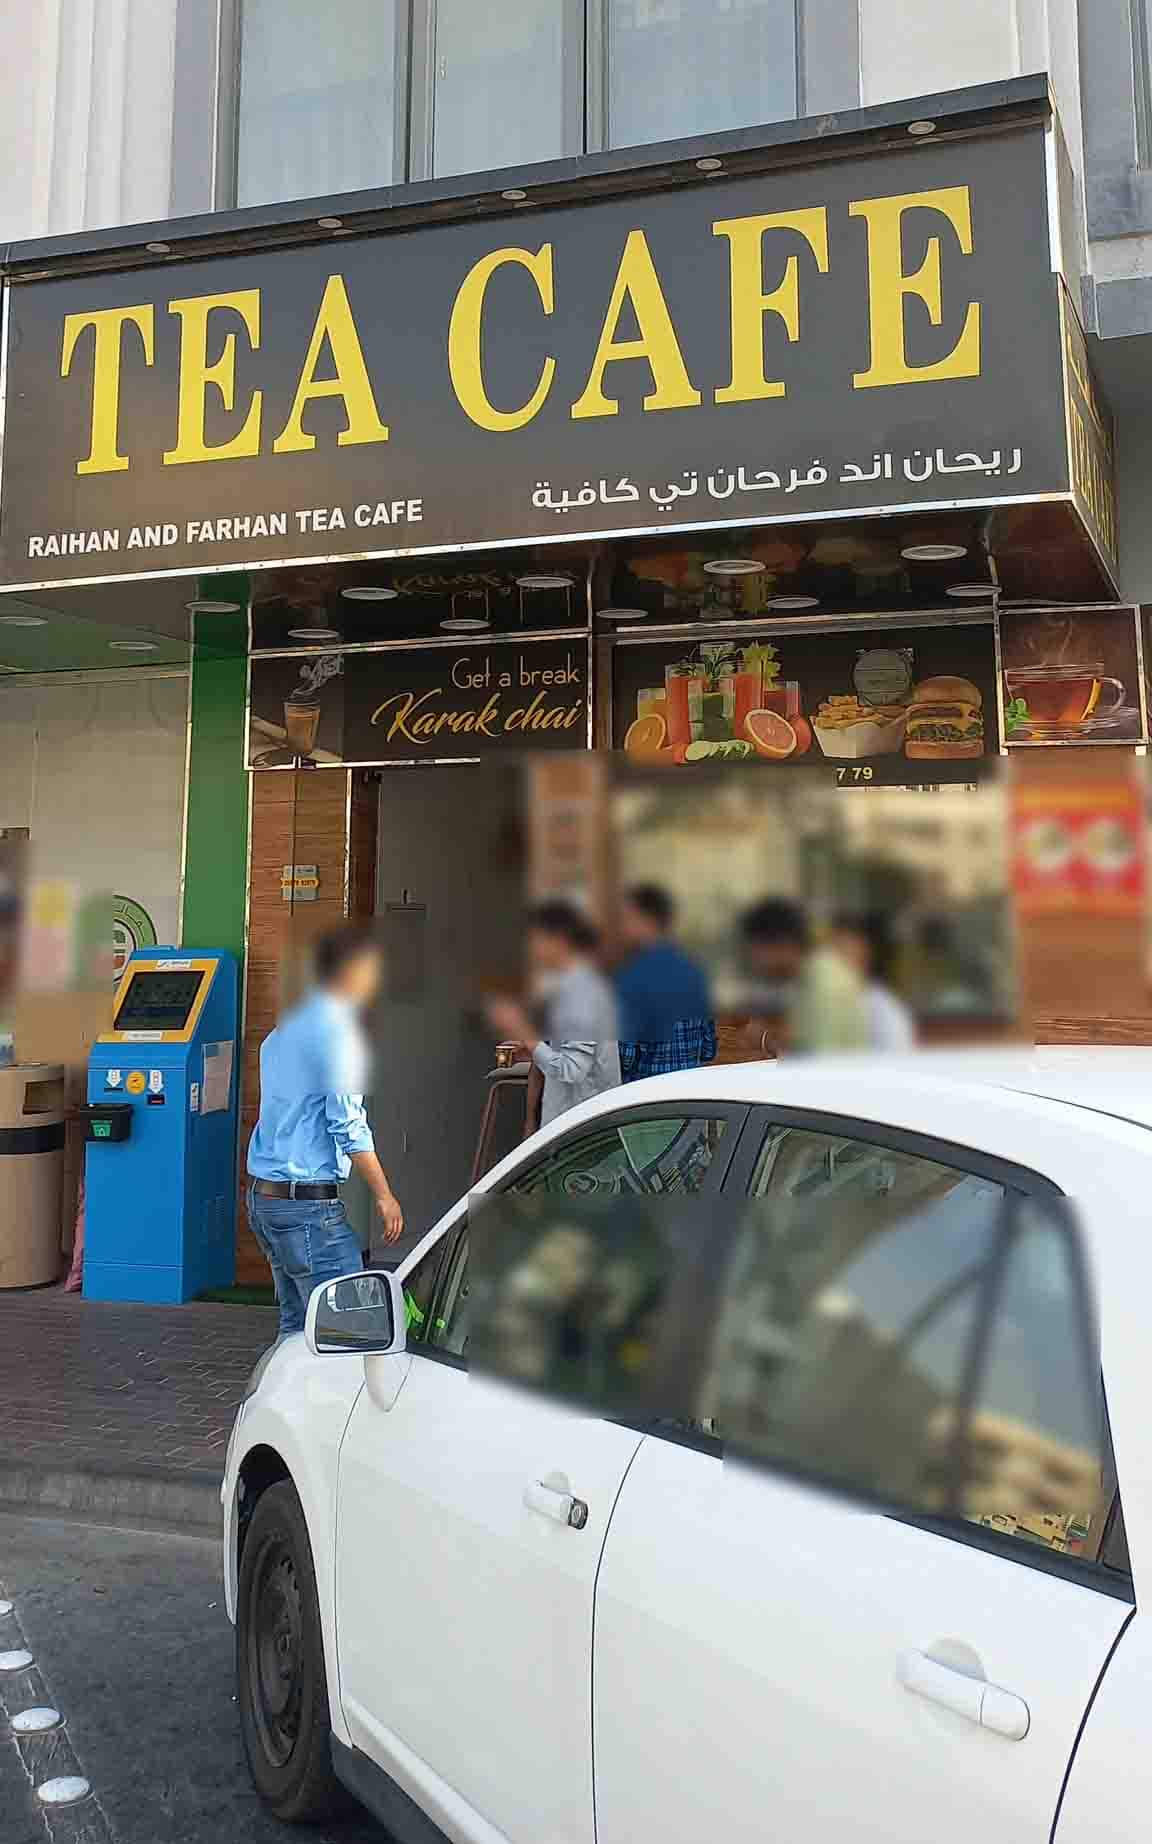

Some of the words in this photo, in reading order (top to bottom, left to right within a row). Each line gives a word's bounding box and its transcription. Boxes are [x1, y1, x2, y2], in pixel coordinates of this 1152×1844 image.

[61, 275, 389, 475] TEA
[448, 186, 981, 432] CAFE
[707, 459, 828, 499] فرحان
[839, 453, 892, 482] اند
[903, 447, 1022, 482] ريحان
[532, 477, 640, 514] كافية
[649, 471, 698, 512] تي
[28, 530, 119, 558] RAIHAN
[127, 524, 178, 549] AND
[186, 513, 287, 543] FARHAN
[296, 507, 346, 533] TEA
[354, 499, 423, 527] CAFE
[451, 656, 490, 689] Get
[499, 672, 512, 688] a
[520, 652, 581, 686] break
[371, 688, 501, 744] Karak
[504, 690, 584, 731] chai
